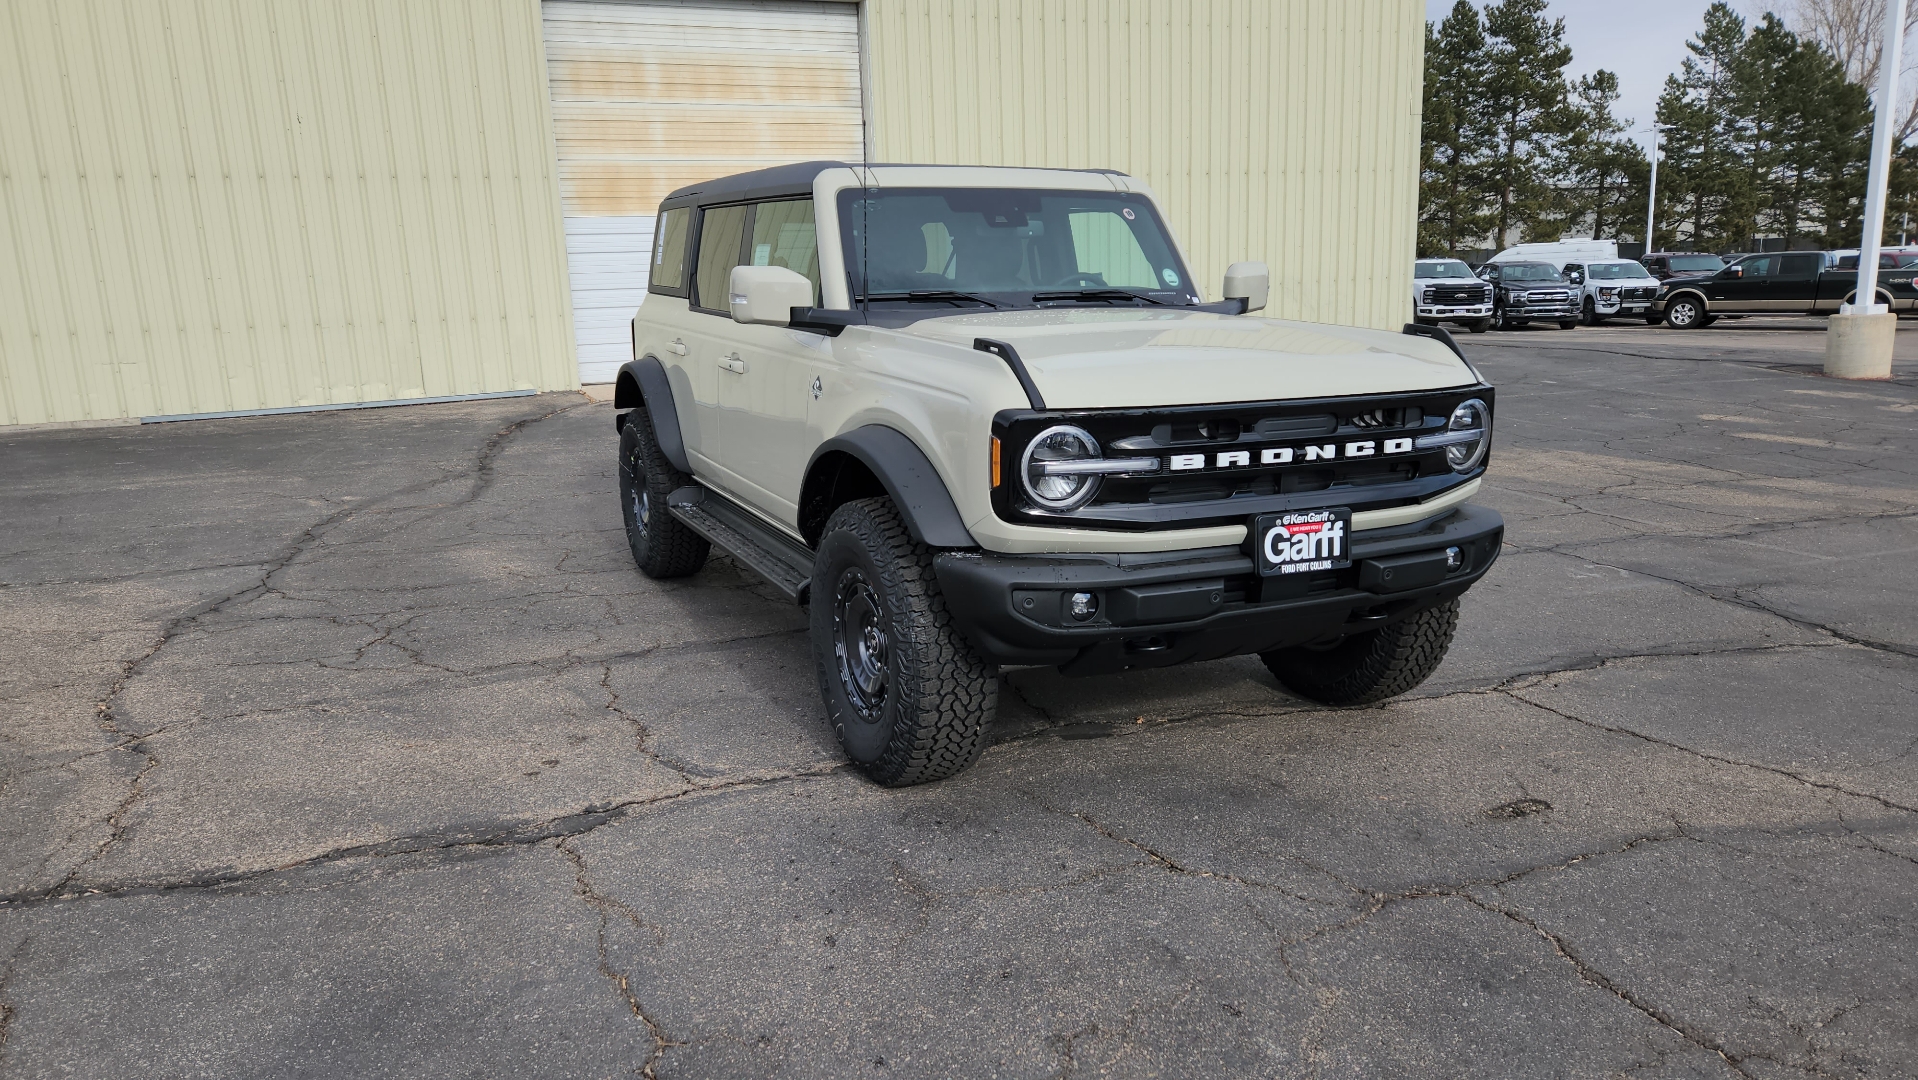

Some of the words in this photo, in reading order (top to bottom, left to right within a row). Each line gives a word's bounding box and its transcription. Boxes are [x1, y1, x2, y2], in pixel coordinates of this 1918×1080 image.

[1170, 437, 1413, 470] BRONCO
[1290, 514, 1308, 525] Ken
[1308, 511, 1329, 522] Garff
[1264, 521, 1343, 563] Garff
[1281, 564, 1296, 574] FORD
[1296, 562, 1309, 572] FORT
[1309, 560, 1332, 571] COLLINS
